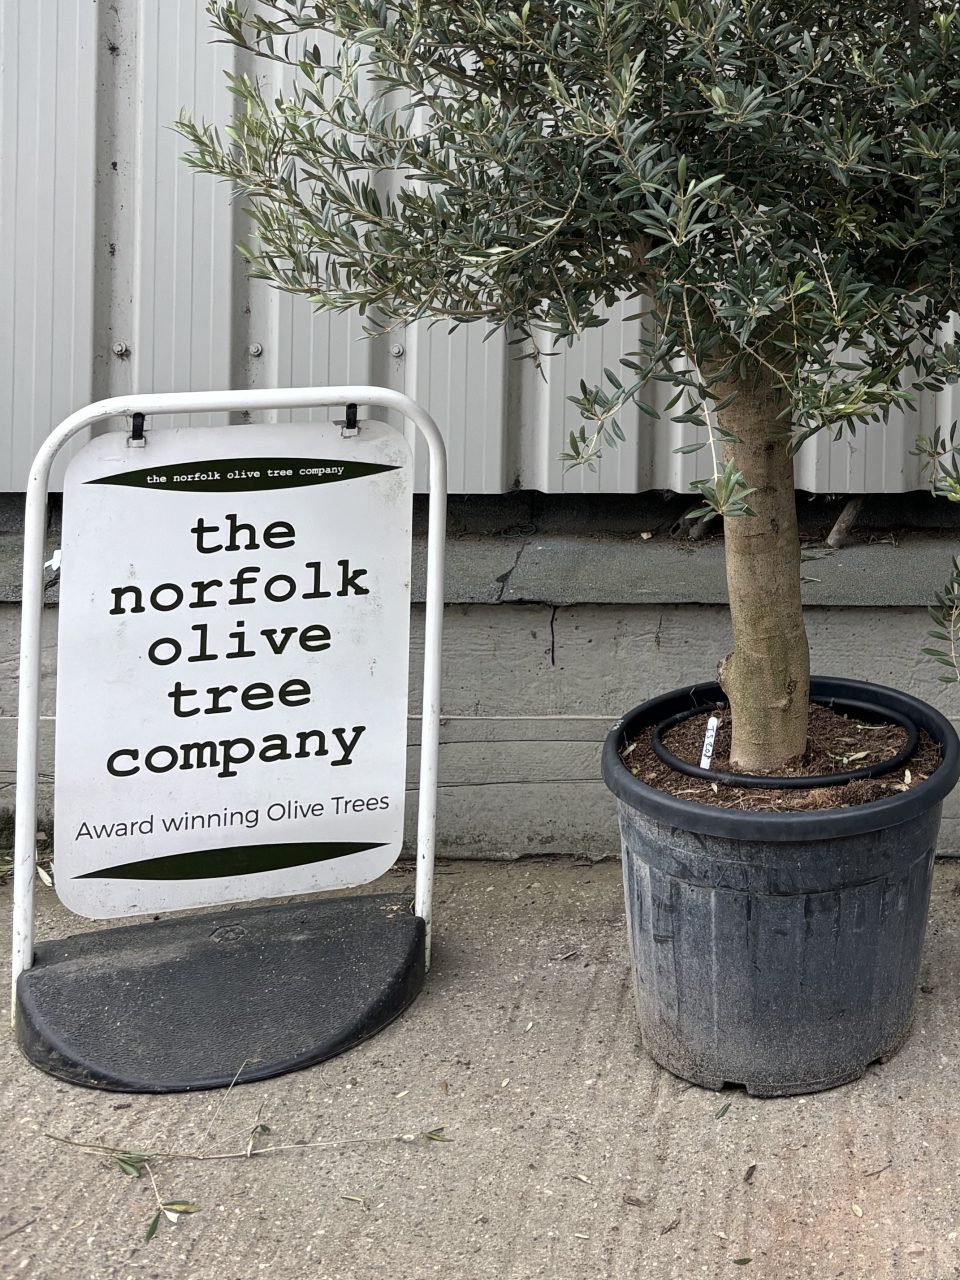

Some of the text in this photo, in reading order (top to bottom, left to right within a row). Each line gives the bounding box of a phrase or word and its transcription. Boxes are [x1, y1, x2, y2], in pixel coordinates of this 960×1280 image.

[146, 466, 345, 484] the norfolk olive tree company
[190, 513, 296, 554] the
[109, 559, 370, 616] norfolk
[147, 620, 332, 666] olive
[167, 678, 311, 718] tree
[106, 725, 367, 778] company
[74, 795, 390, 841] Award winning Olive Trees
